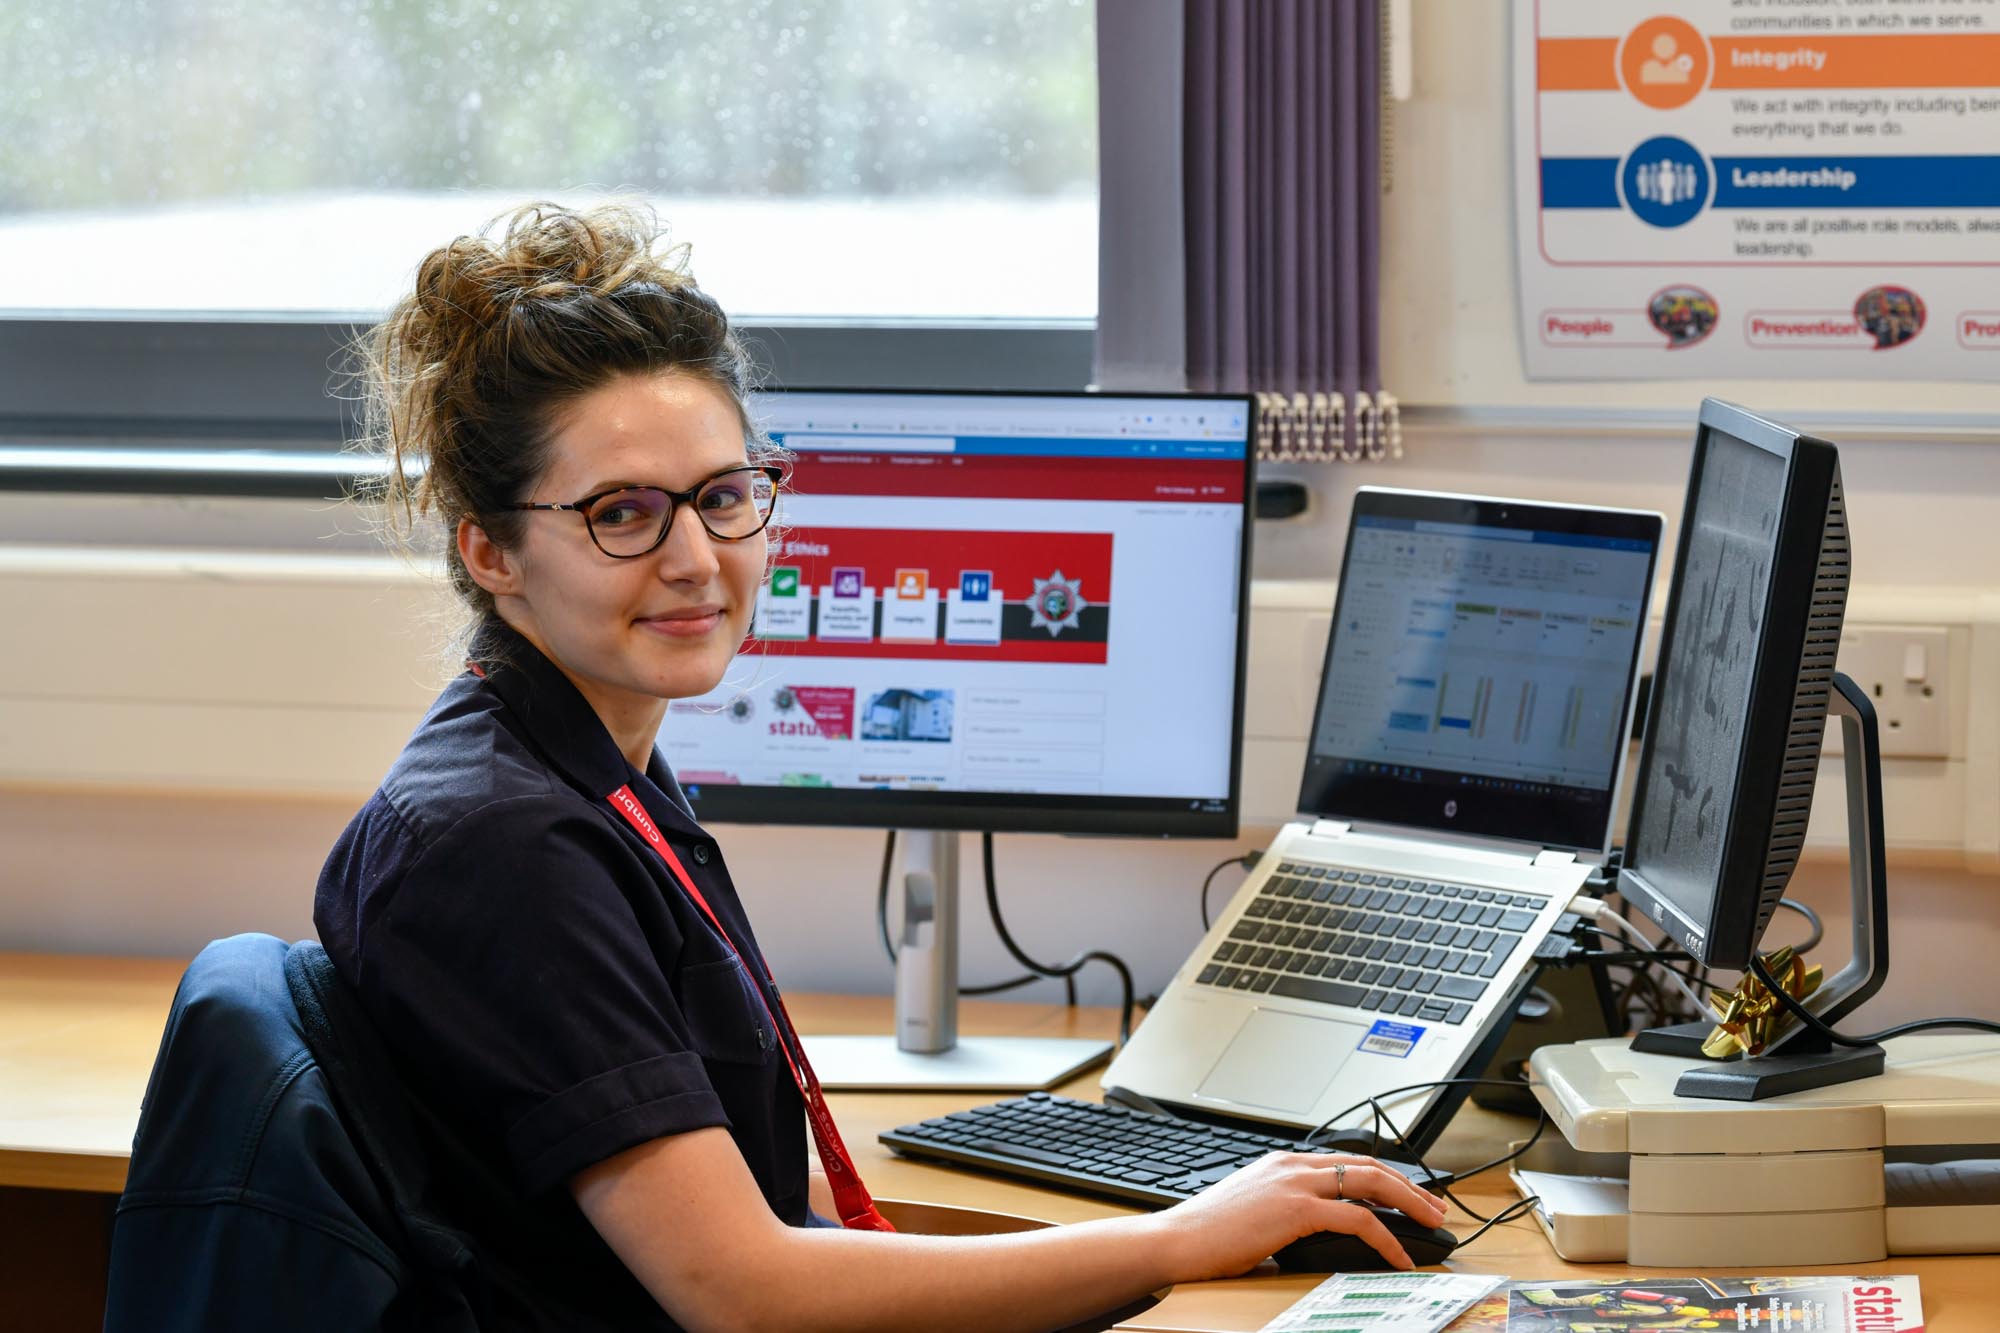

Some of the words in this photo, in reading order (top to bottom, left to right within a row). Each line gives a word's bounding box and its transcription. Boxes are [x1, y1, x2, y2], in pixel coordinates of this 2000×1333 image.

[1731, 14, 1832, 30] communities
[1837, 15, 1851, 28] in
[1856, 13, 1903, 28] which
[1908, 16, 1931, 27] we
[1937, 14, 1985, 27] serve.
[1731, 48, 1827, 70] Integrity
[1731, 98, 1759, 113] We
[1763, 99, 1787, 113] act
[1791, 98, 1823, 113] with
[1828, 98, 1890, 116] integrity
[1896, 96, 1967, 116] including
[1732, 121, 1815, 139] everything
[1818, 120, 1848, 136] that
[1853, 123, 1876, 135] we
[1880, 120, 1905, 135] do.
[1732, 167, 1857, 191] Leadership
[1734, 218, 1759, 232] We
[1764, 221, 1789, 232] are
[1792, 217, 1808, 232] all
[1812, 217, 1867, 235] positive
[1871, 217, 1899, 232] role
[1903, 216, 1963, 233] models,
[1735, 240, 1813, 257] leadership.
[1547, 318, 1612, 337] People
[1751, 319, 1859, 338] Prevention
[786, 541, 829, 556] Ethics
